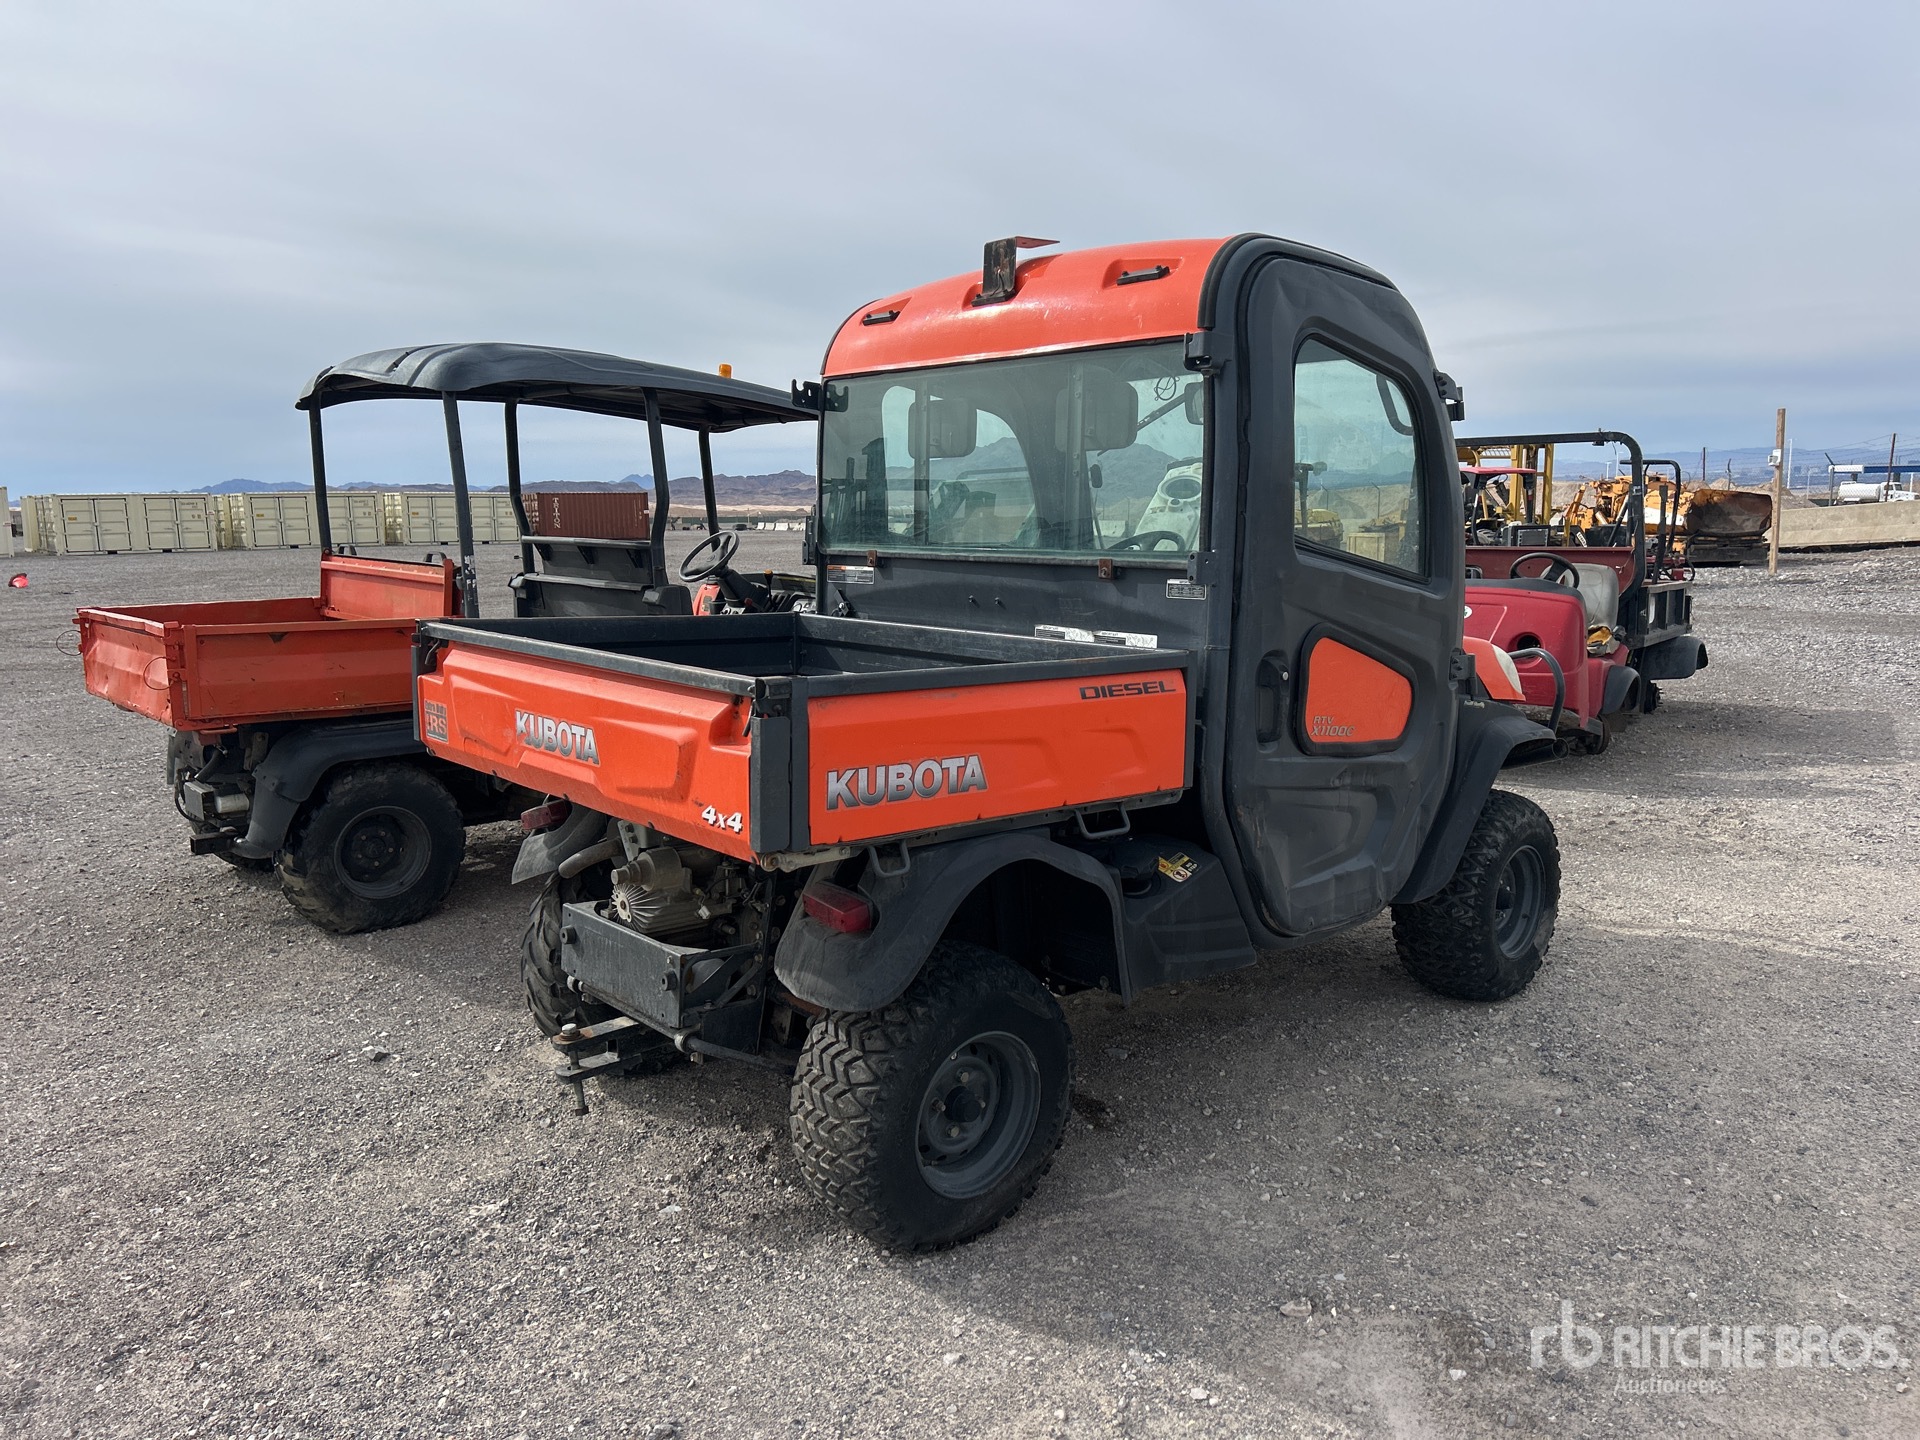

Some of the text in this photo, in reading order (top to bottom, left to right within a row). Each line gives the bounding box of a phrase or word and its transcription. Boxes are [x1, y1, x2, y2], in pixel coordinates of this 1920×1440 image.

[552, 497, 561, 529] TRITON
[1079, 680, 1177, 700] DIESEL
[1311, 725, 1355, 736] X1100C
[1313, 715, 1334, 725] RTV
[515, 709, 600, 766] KUBOTA
[826, 754, 988, 811] KUBOTA
[701, 805, 743, 834] 4x4
